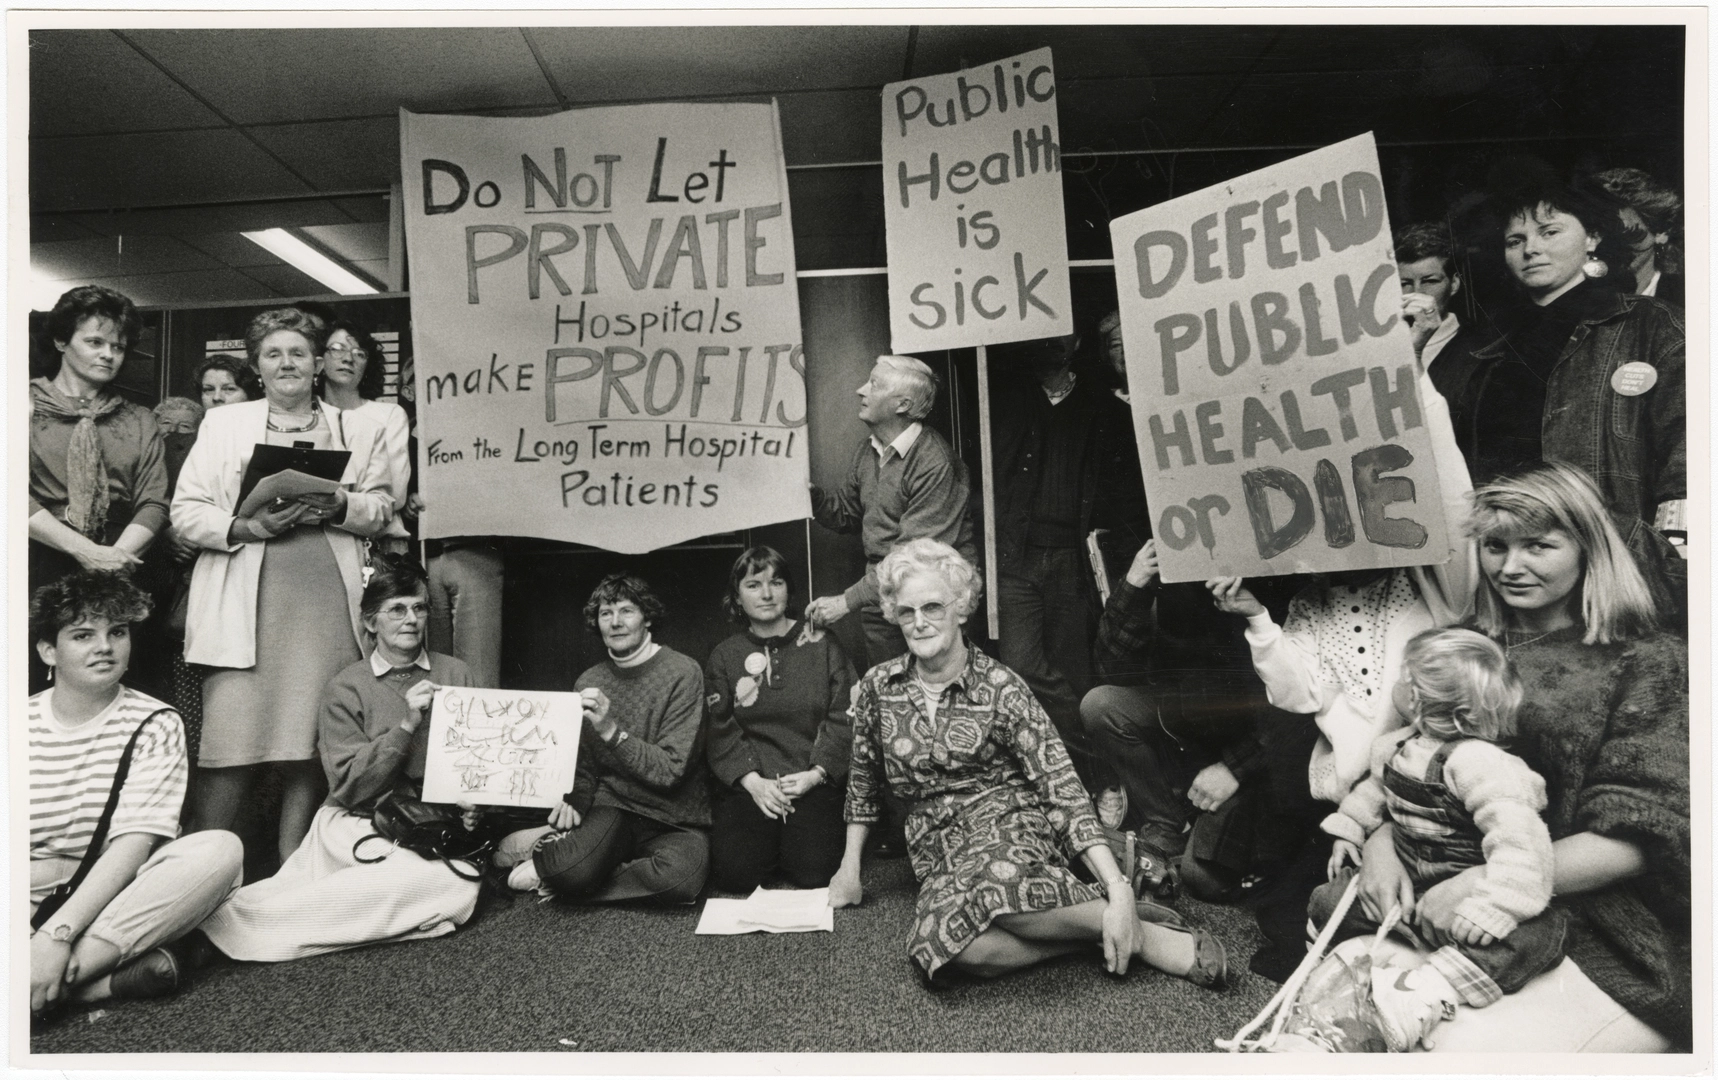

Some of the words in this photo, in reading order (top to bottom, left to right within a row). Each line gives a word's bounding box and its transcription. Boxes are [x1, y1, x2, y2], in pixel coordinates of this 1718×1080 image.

[895, 61, 1055, 137] Public
[421, 158, 501, 216] Do
[646, 137, 737, 203] Let
[898, 124, 1061, 209] Health
[465, 202, 784, 304] PRIVATE
[956, 204, 1000, 250] is
[1134, 171, 1384, 299] DEFEND
[554, 298, 742, 347] Hospitals
[1154, 263, 1398, 396] PUBLIC
[545, 343, 808, 428] PROFITS
[1148, 364, 1423, 471] HEALTH
[428, 439, 463, 467] From
[472, 437, 501, 459] the
[514, 428, 578, 465] Long
[587, 425, 650, 460] Term
[665, 424, 795, 472] Hospital
[561, 470, 719, 508] Patients
[1158, 494, 1231, 560] or
[1241, 444, 1429, 560] DIE
